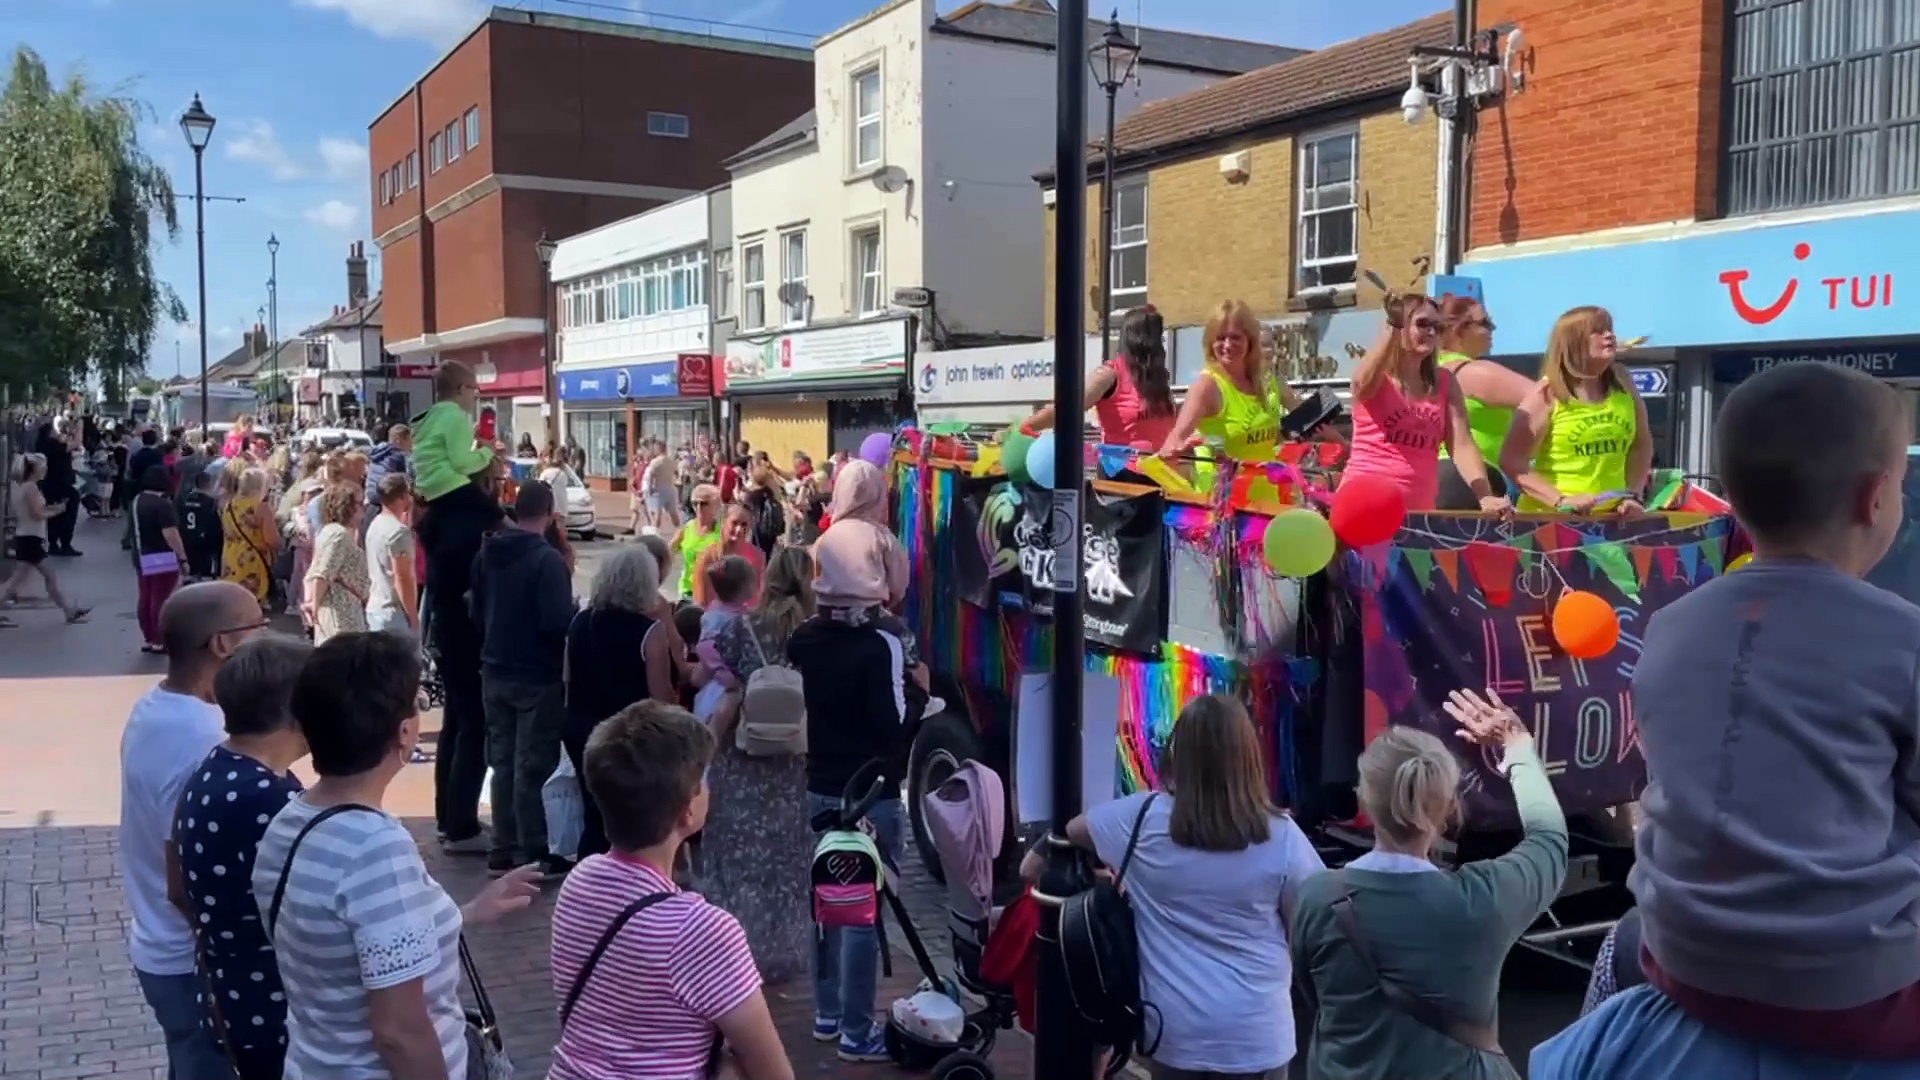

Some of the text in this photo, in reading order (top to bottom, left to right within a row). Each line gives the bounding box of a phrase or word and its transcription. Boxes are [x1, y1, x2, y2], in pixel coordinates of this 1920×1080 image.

[1821, 273, 1892, 310] TUI
[945, 359, 1056, 386] john trewin opticia
[1752, 352, 1898, 373] TRA MONEY
[187, 511, 196, 529] 9
